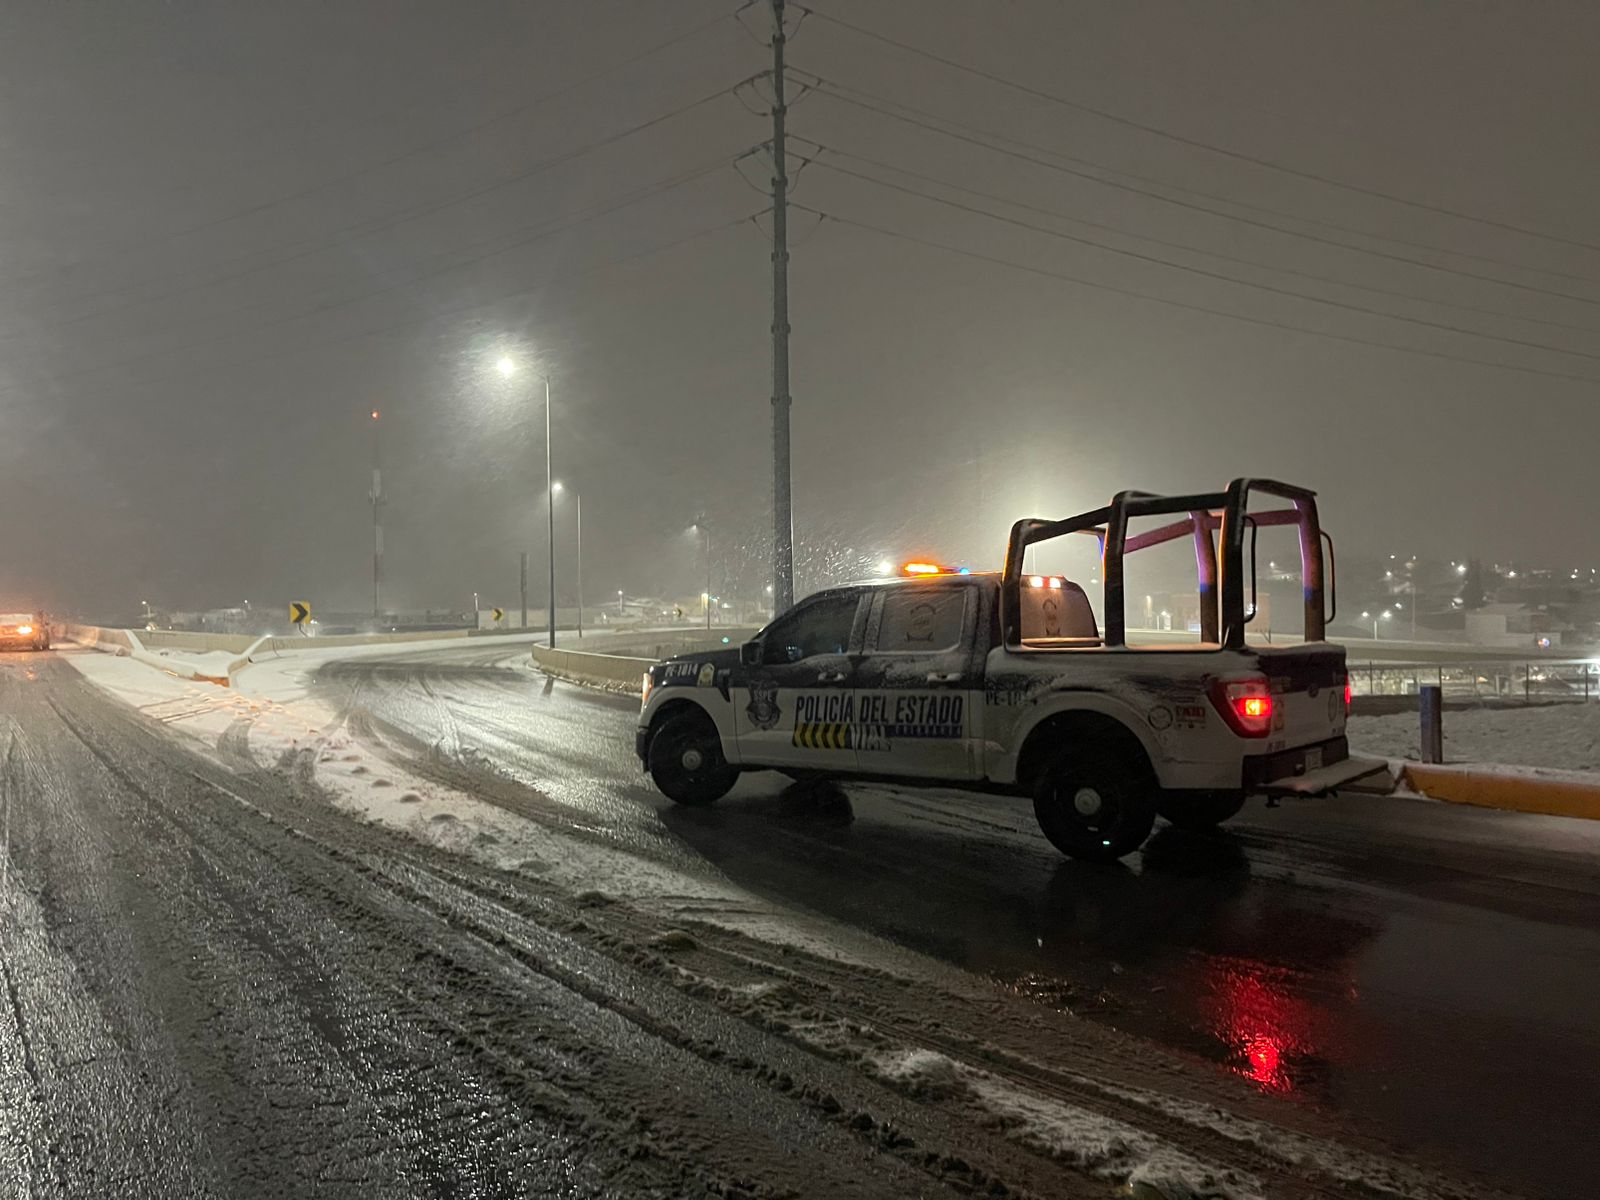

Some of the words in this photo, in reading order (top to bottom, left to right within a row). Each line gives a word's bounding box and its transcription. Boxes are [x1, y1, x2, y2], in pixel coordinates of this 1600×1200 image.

[796, 692, 853, 724] POLICÍA
[859, 695, 889, 724] DEL
[896, 695, 963, 725] ESTADO
